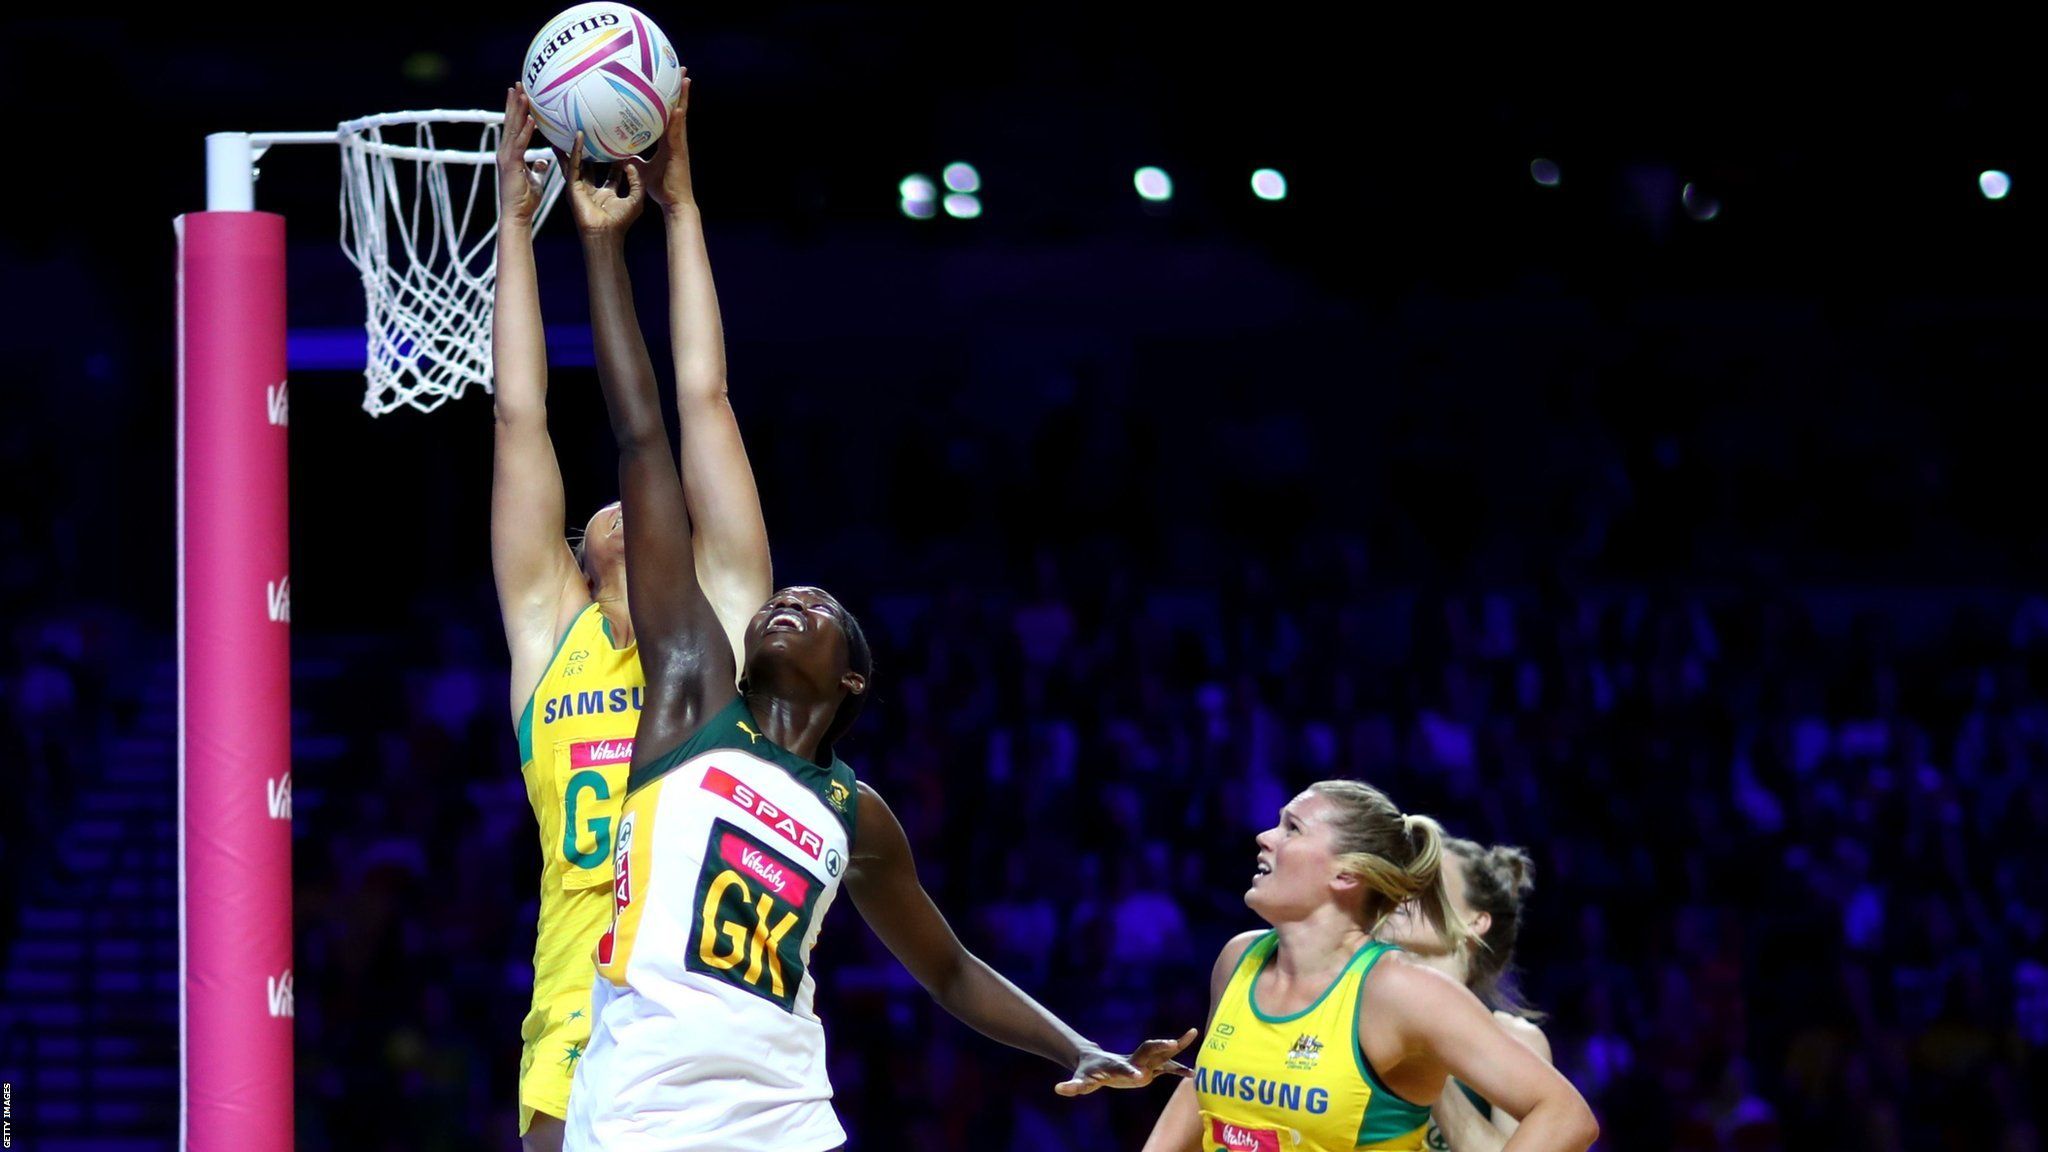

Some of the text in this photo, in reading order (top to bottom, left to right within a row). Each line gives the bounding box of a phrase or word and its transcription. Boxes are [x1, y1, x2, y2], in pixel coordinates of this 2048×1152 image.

[527, 13, 619, 89] GILBERT
[544, 686, 644, 724] SAMSU
[590, 740, 632, 761] Vitalit
[562, 770, 611, 869] G
[732, 785, 821, 857] SPAR
[742, 846, 786, 892] Vitality
[699, 869, 798, 998] GK
[1194, 1067, 1328, 1115] AMSUNG
